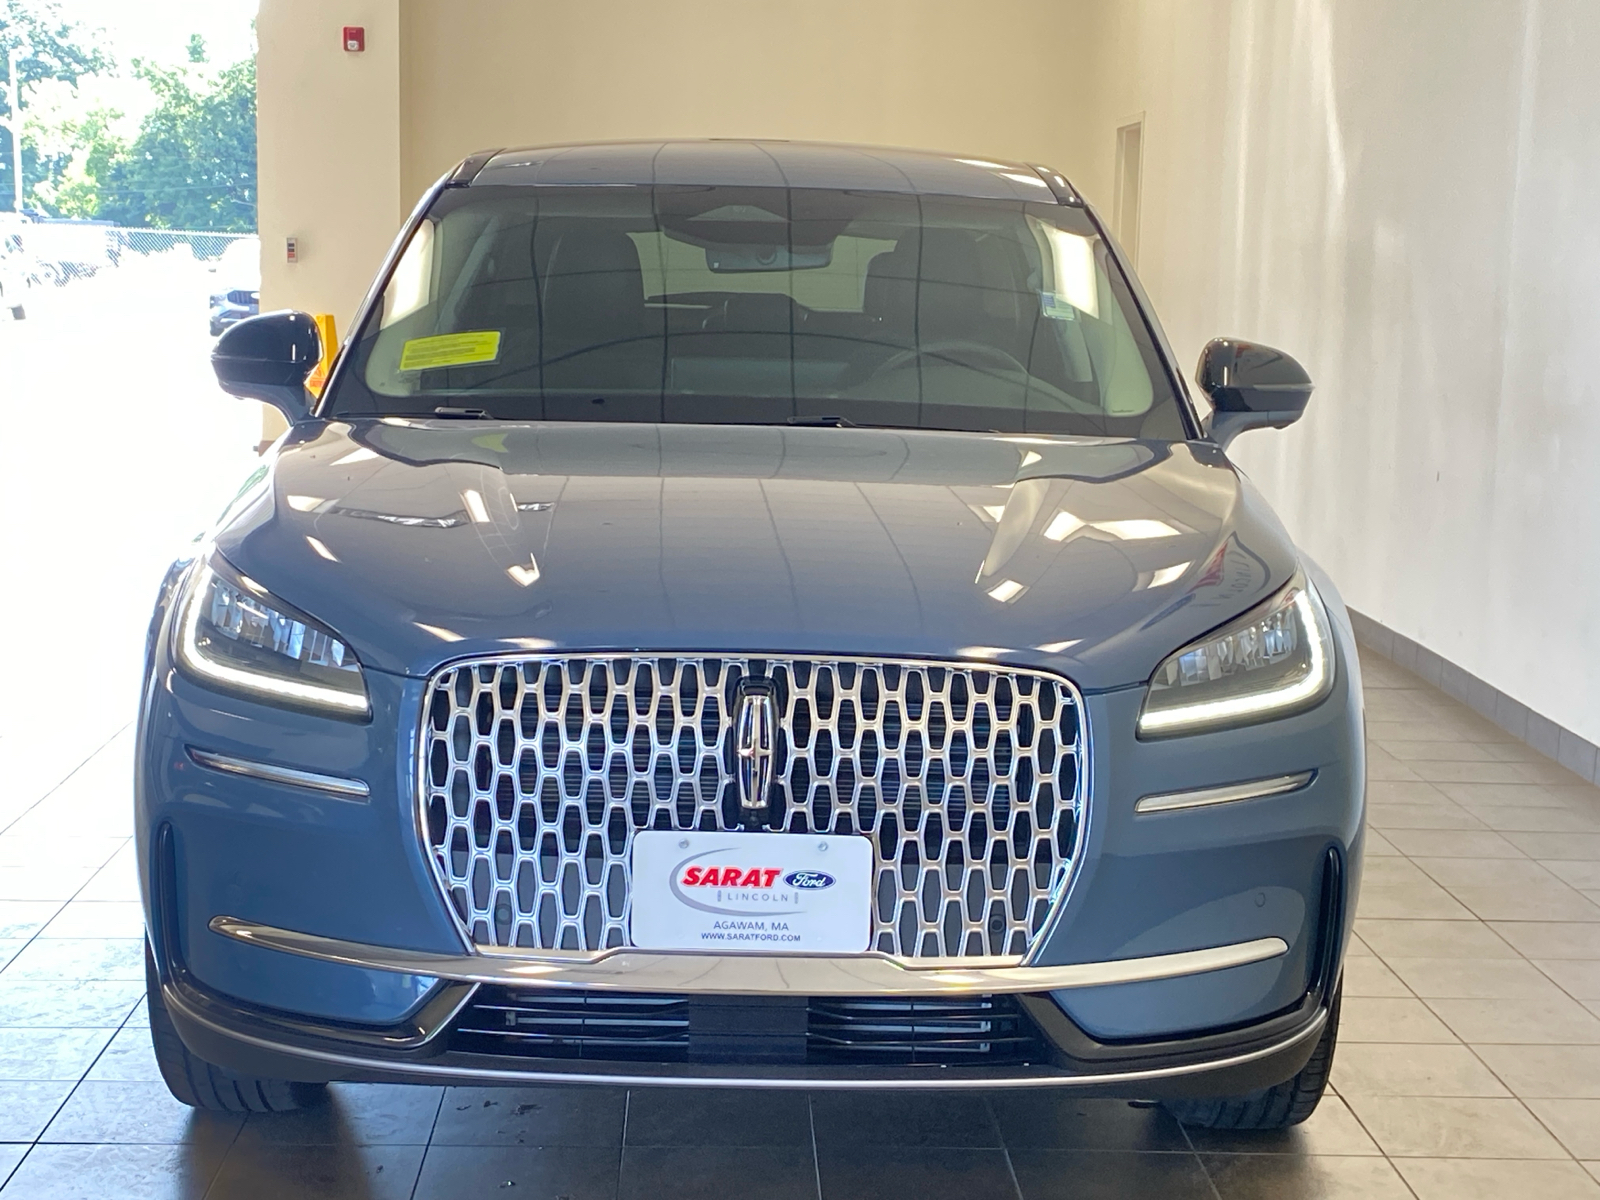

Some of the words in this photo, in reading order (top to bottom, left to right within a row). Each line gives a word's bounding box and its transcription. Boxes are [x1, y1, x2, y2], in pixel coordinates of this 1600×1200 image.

[682, 866, 782, 888] SARAT
[792, 872, 826, 887] Ford
[727, 892, 789, 902] LINCOLN
[713, 920, 768, 931] AGAWAM,
[771, 921, 790, 931] MA
[701, 932, 801, 942] WWW.SARATFORD.COM
